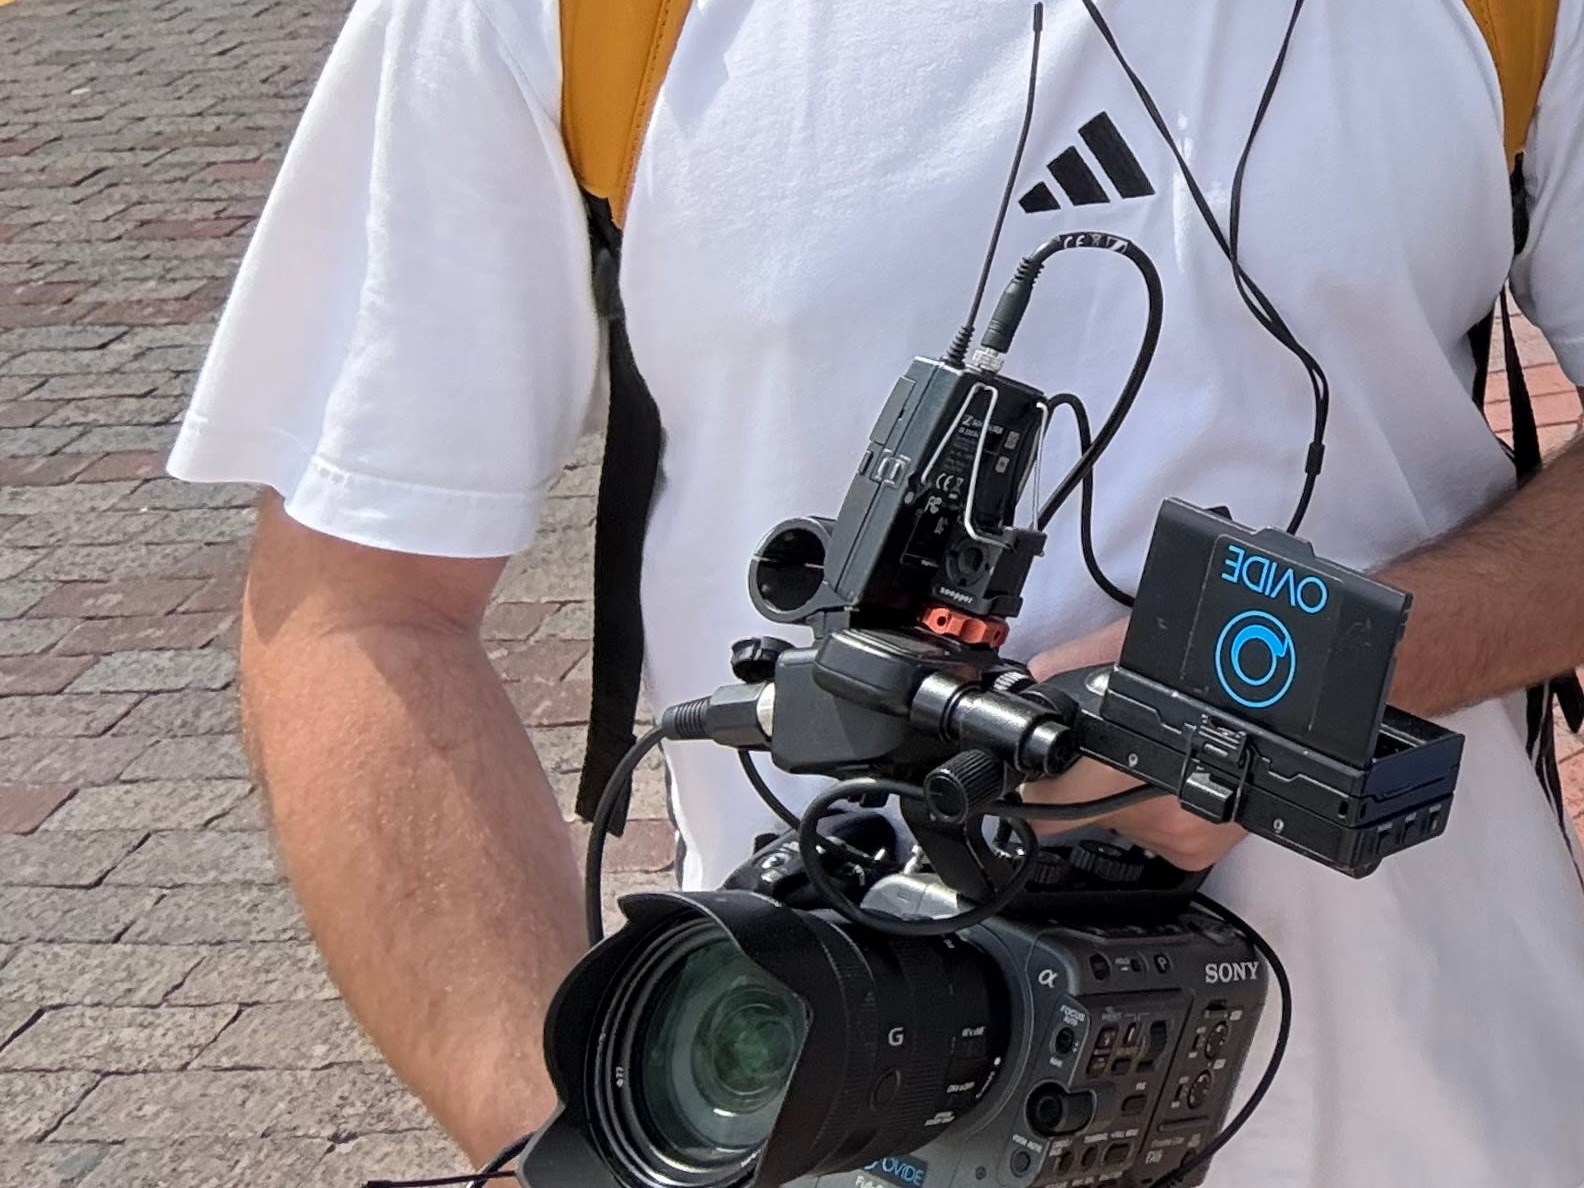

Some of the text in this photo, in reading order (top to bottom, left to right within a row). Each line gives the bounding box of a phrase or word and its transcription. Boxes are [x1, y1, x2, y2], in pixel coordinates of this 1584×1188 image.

[1221, 545, 1328, 613] OVIDE
[1205, 962, 1260, 984] SONY
[888, 1027, 904, 1046] G
[882, 1157, 924, 1186] OVIDE
